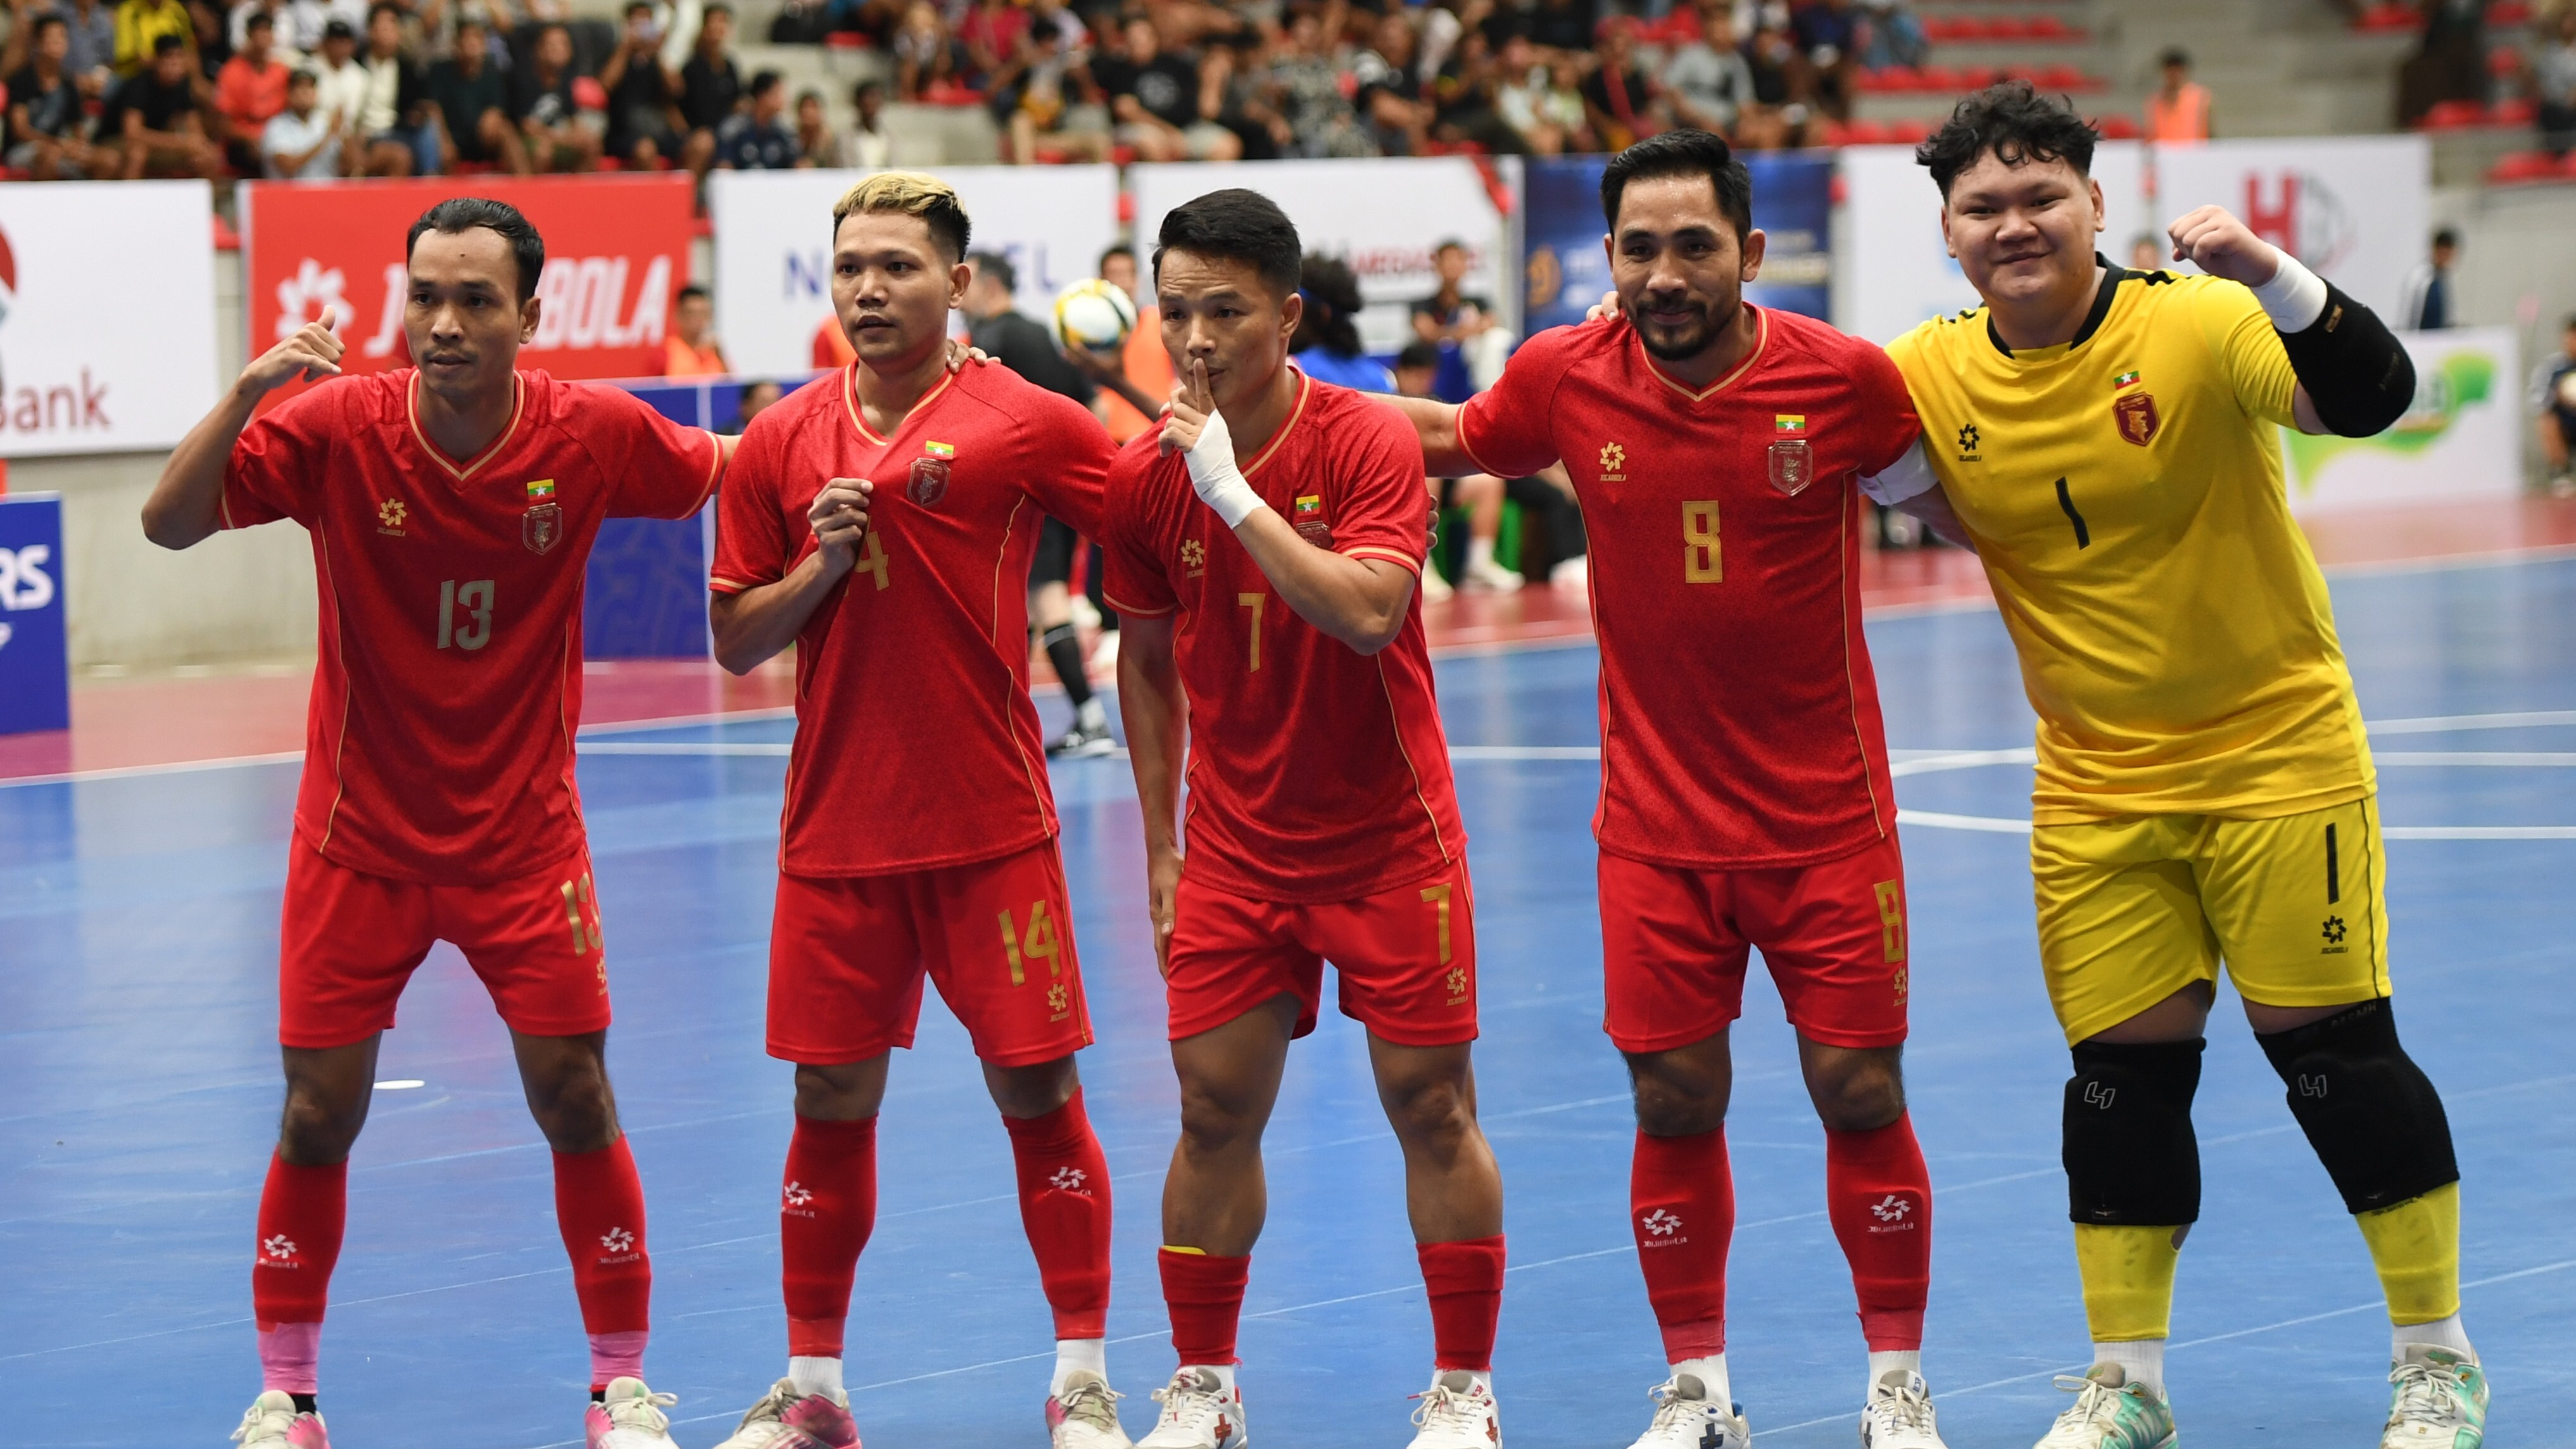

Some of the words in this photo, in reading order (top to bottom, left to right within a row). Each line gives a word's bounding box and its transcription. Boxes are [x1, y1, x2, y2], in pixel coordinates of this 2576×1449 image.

[363, 253, 672, 358] JBOLA
[0, 363, 112, 433] ank
[1682, 500, 1722, 583] 8
[2055, 476, 2090, 550] 1
[438, 580, 495, 650] 13
[1238, 593, 1266, 673] 7
[2326, 822, 2340, 905] 1
[560, 871, 602, 957] 13
[998, 899, 1060, 987] 14
[1420, 882, 1451, 966] 7
[1874, 879, 1905, 963] 8
